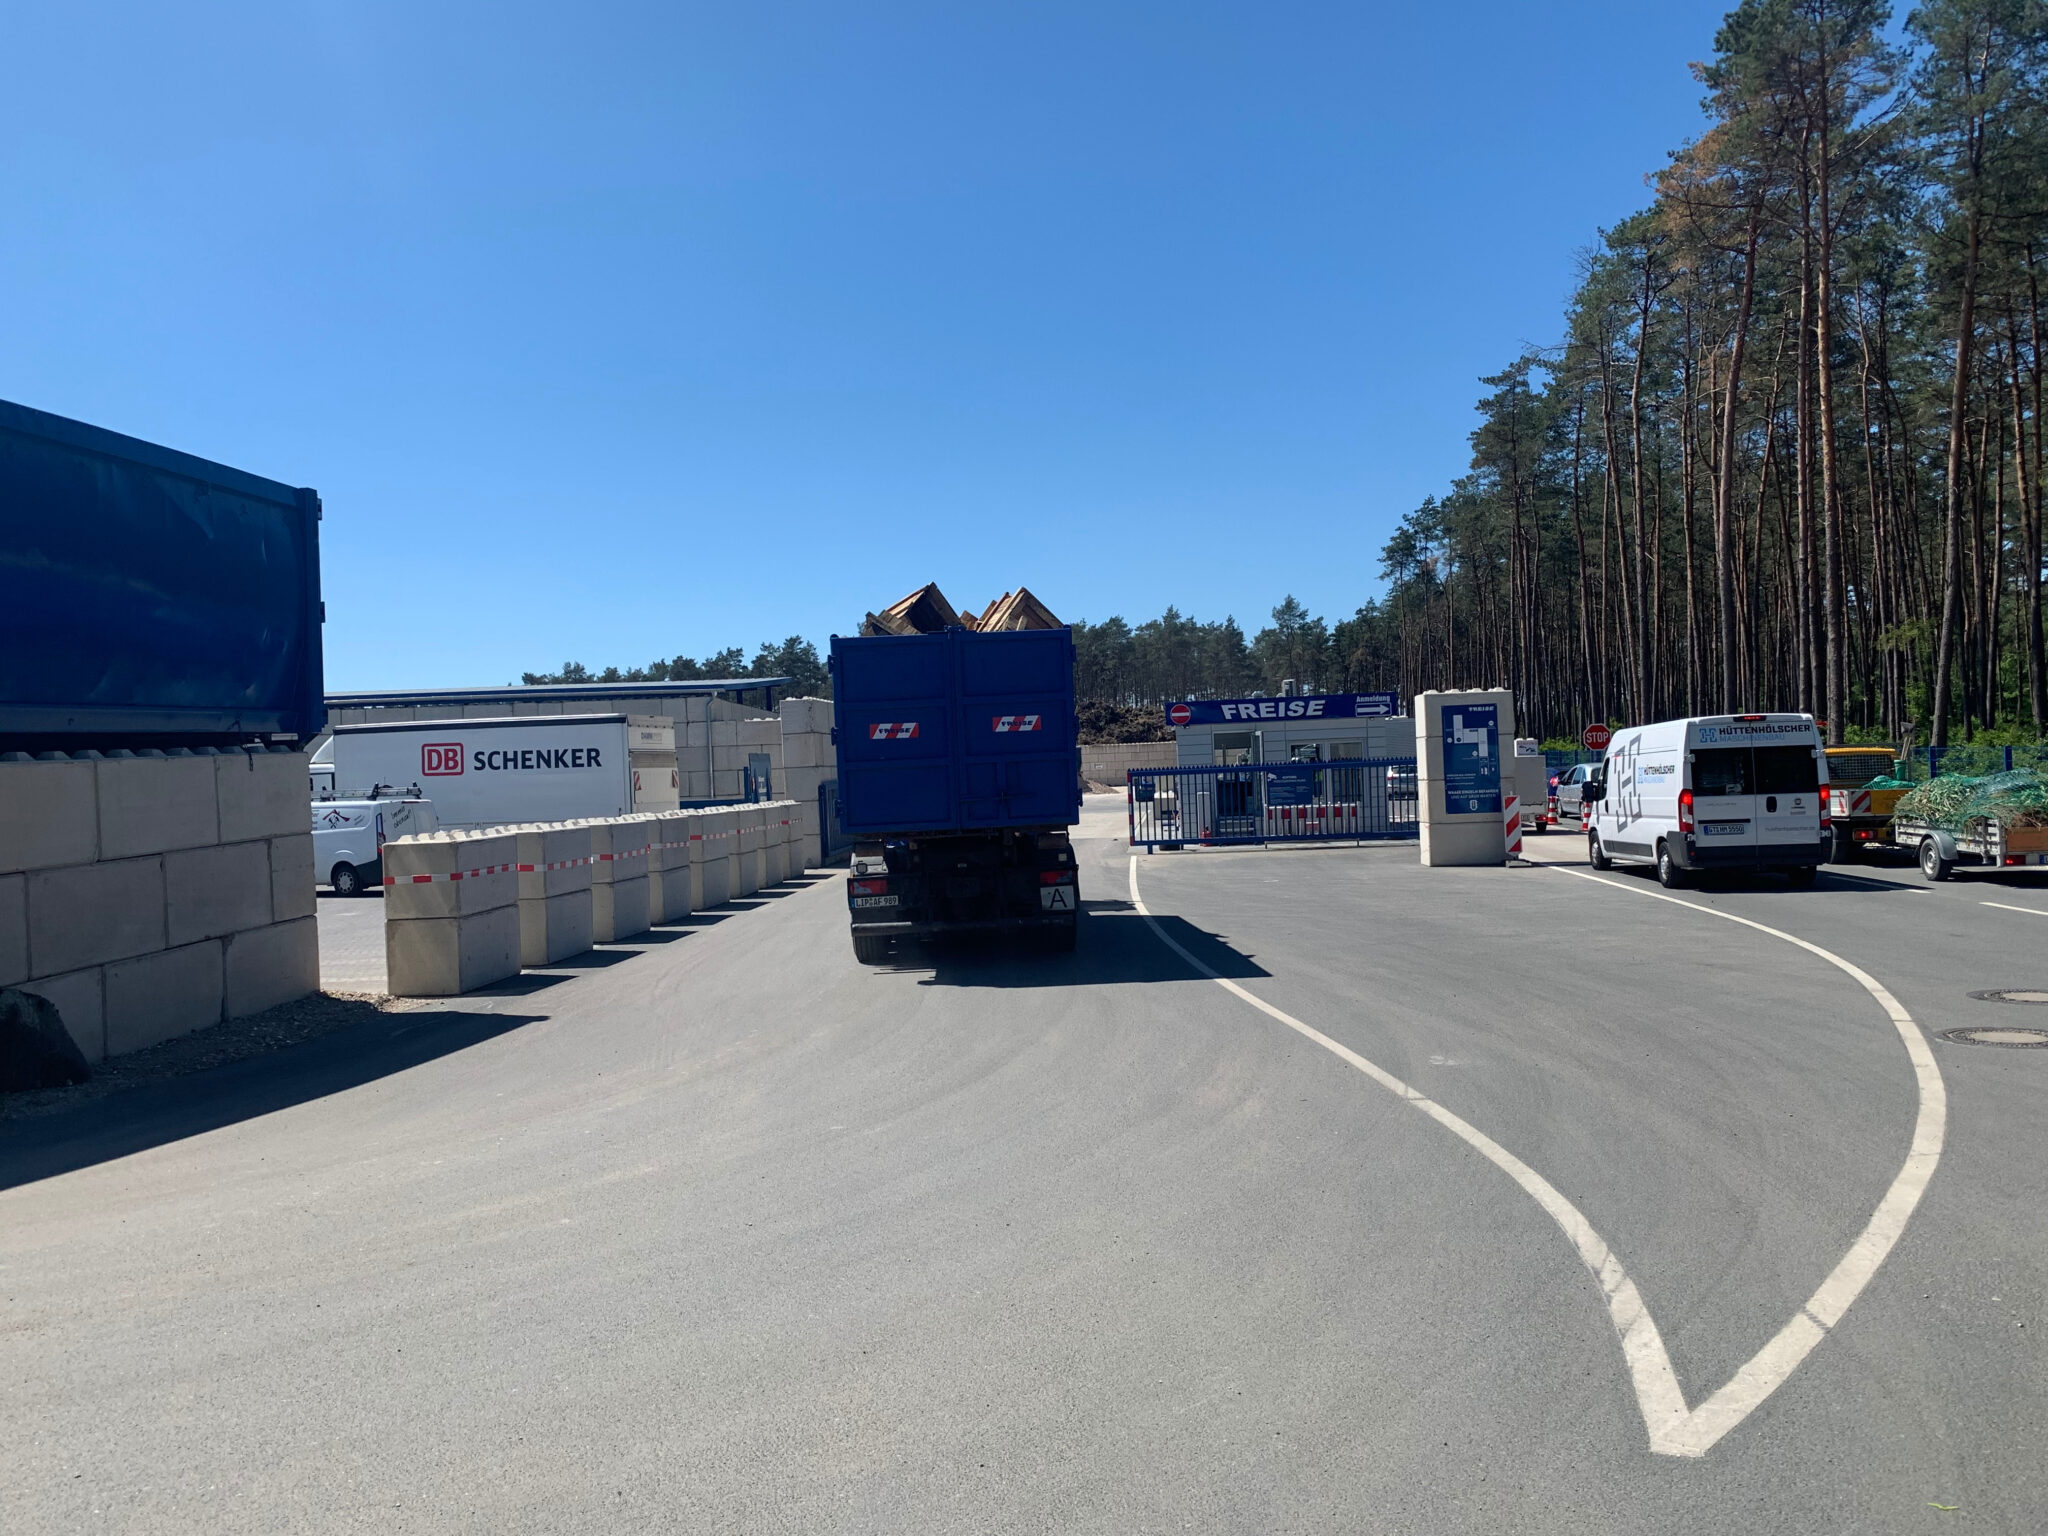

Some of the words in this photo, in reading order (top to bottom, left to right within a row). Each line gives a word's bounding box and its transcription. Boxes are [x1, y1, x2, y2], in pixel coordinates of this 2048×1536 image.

[1356, 695, 1391, 703] Anmeldung
[1221, 700, 1326, 720] FREISE
[1719, 724, 1811, 735] HÜTTENHÖLSCHER
[1586, 732, 1609, 743] STOP
[427, 748, 459, 771] DB
[473, 748, 602, 771] SCHENKER
[883, 896, 897, 905] 989
[1049, 888, 1068, 909] A
